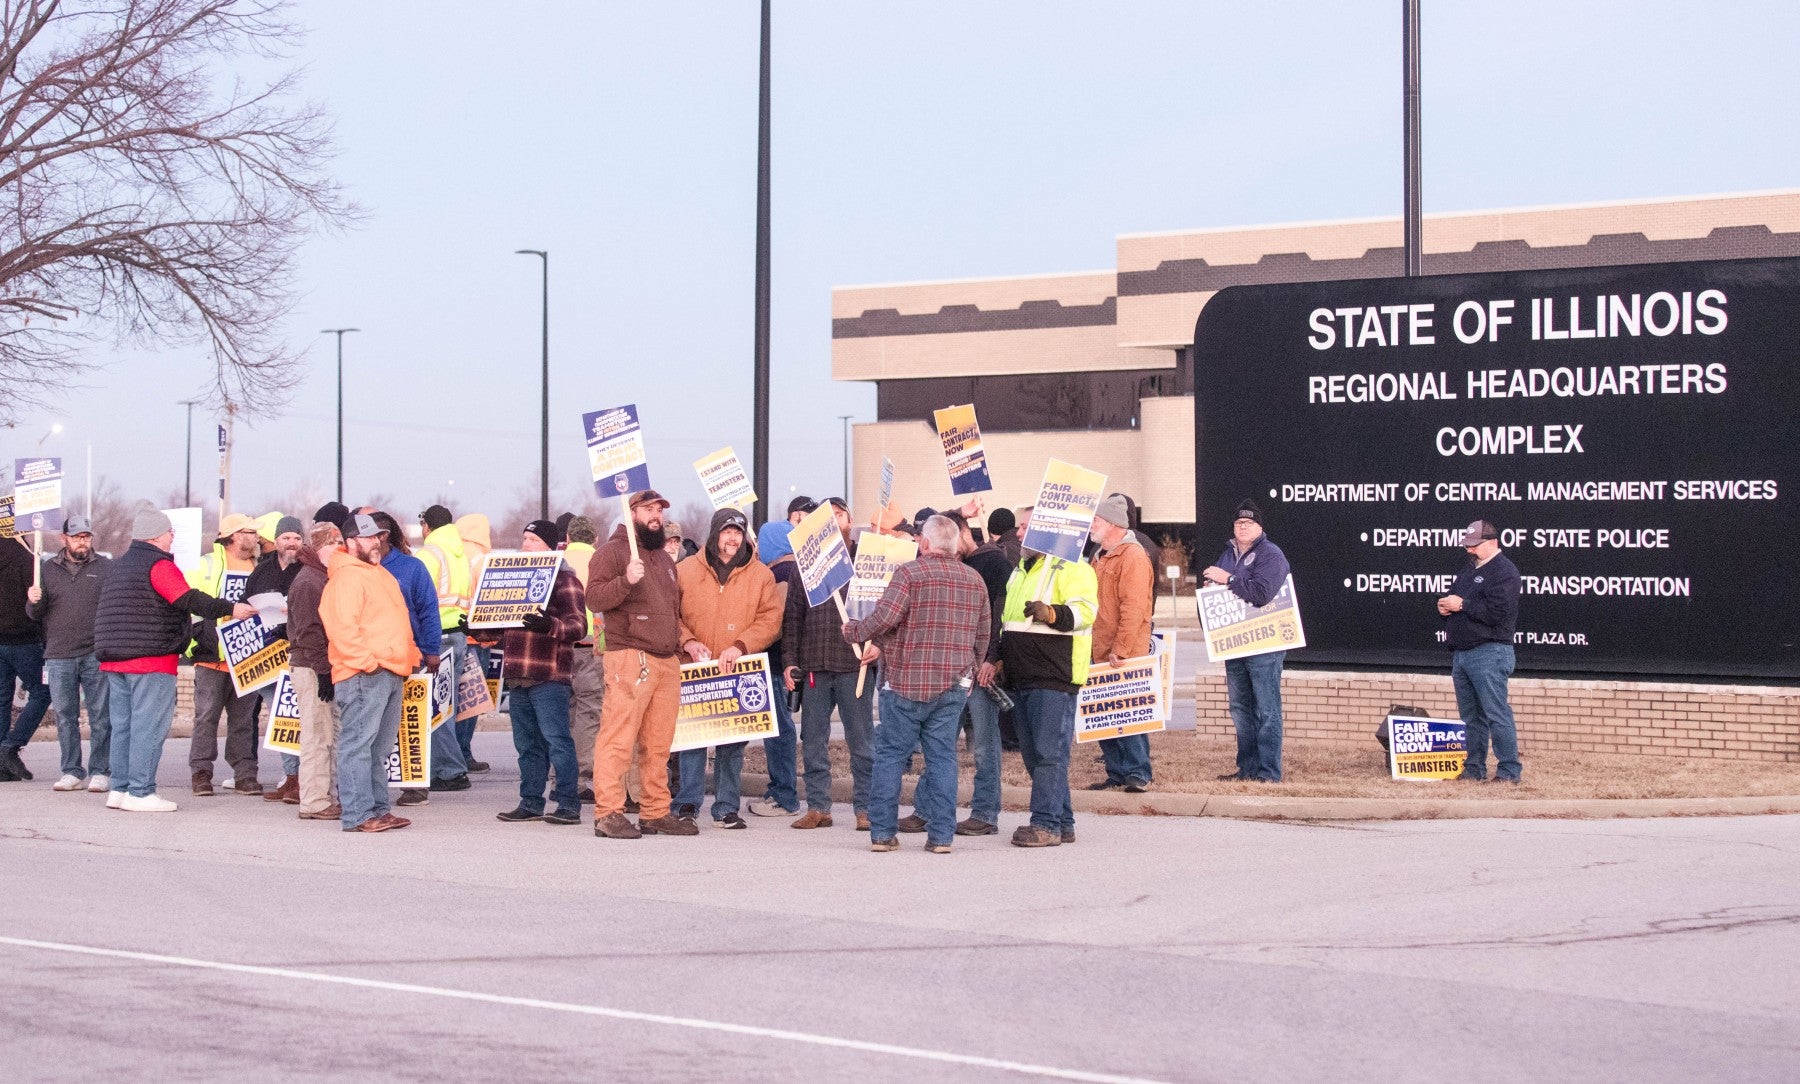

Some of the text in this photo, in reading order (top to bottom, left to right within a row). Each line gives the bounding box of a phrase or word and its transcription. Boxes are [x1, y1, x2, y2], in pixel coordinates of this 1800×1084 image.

[1308, 289, 1728, 350] STATE OF ILLINOIS
[1309, 363, 1727, 403] REGIONAL HEADQUARTERS
[940, 427, 958, 440] FAIR
[943, 428, 975, 448] CONTRACT
[1436, 425, 1584, 456] COMPLEX
[945, 443, 964, 457] NOW
[704, 464, 721, 476] STAND
[721, 457, 737, 467] WITH
[709, 473, 745, 494] TEAMSTERS
[1043, 482, 1072, 492] FAIR
[1282, 480, 1778, 501] DEPARTMENT OF CENTRAL MANAGEMENT SERVICES
[1037, 500, 1070, 510] NOW
[1041, 490, 1092, 506] CONTRACT
[799, 523, 834, 566] CONTRACT
[1373, 528, 1669, 548] DEPARTME OF STATE POLICE
[797, 534, 815, 559] FAIR
[489, 556, 556, 567] I STAND WITH
[801, 546, 822, 574] NOW
[858, 554, 885, 562] FAIR
[855, 563, 899, 574] CONTRAC
[856, 572, 885, 580] NOW
[1356, 574, 1690, 596] DEPARTME TRANSPORTATION
[479, 587, 528, 602] TEAMSTERS
[1203, 590, 1237, 609] FAI
[475, 605, 514, 614] FIGHTING
[516, 604, 533, 613] FOR
[1208, 603, 1277, 631] NOW FOR
[472, 613, 525, 622] FAIR CONTRA
[223, 617, 256, 643] FAIR
[1212, 624, 1276, 653] TEAMSTERS
[1527, 632, 1565, 644] PLAZA
[1569, 633, 1588, 645] DR.
[230, 637, 264, 665] NOW
[1085, 668, 1153, 686] STAND WITH
[695, 679, 737, 693] DEPARTMENT
[1083, 680, 1149, 695] ILLINOIS DEPARTMENT
[1093, 686, 1151, 699] TRANSPORTATION
[681, 689, 733, 704] RANSPORTATION
[1081, 694, 1156, 715] TEAMSTERS
[679, 698, 739, 719] EAMSTERS
[1085, 708, 1153, 724] FIGHTING FOR
[734, 715, 758, 726] FOR
[762, 713, 770, 721] A
[1111, 715, 1154, 726] CONTRACT.
[1394, 722, 1429, 733] FAIR
[406, 705, 423, 780] TEAMSTERS
[1395, 731, 1466, 742] CONTRAC
[1396, 742, 1433, 753] NOW
[1398, 760, 1458, 774] TEAMSTERS
